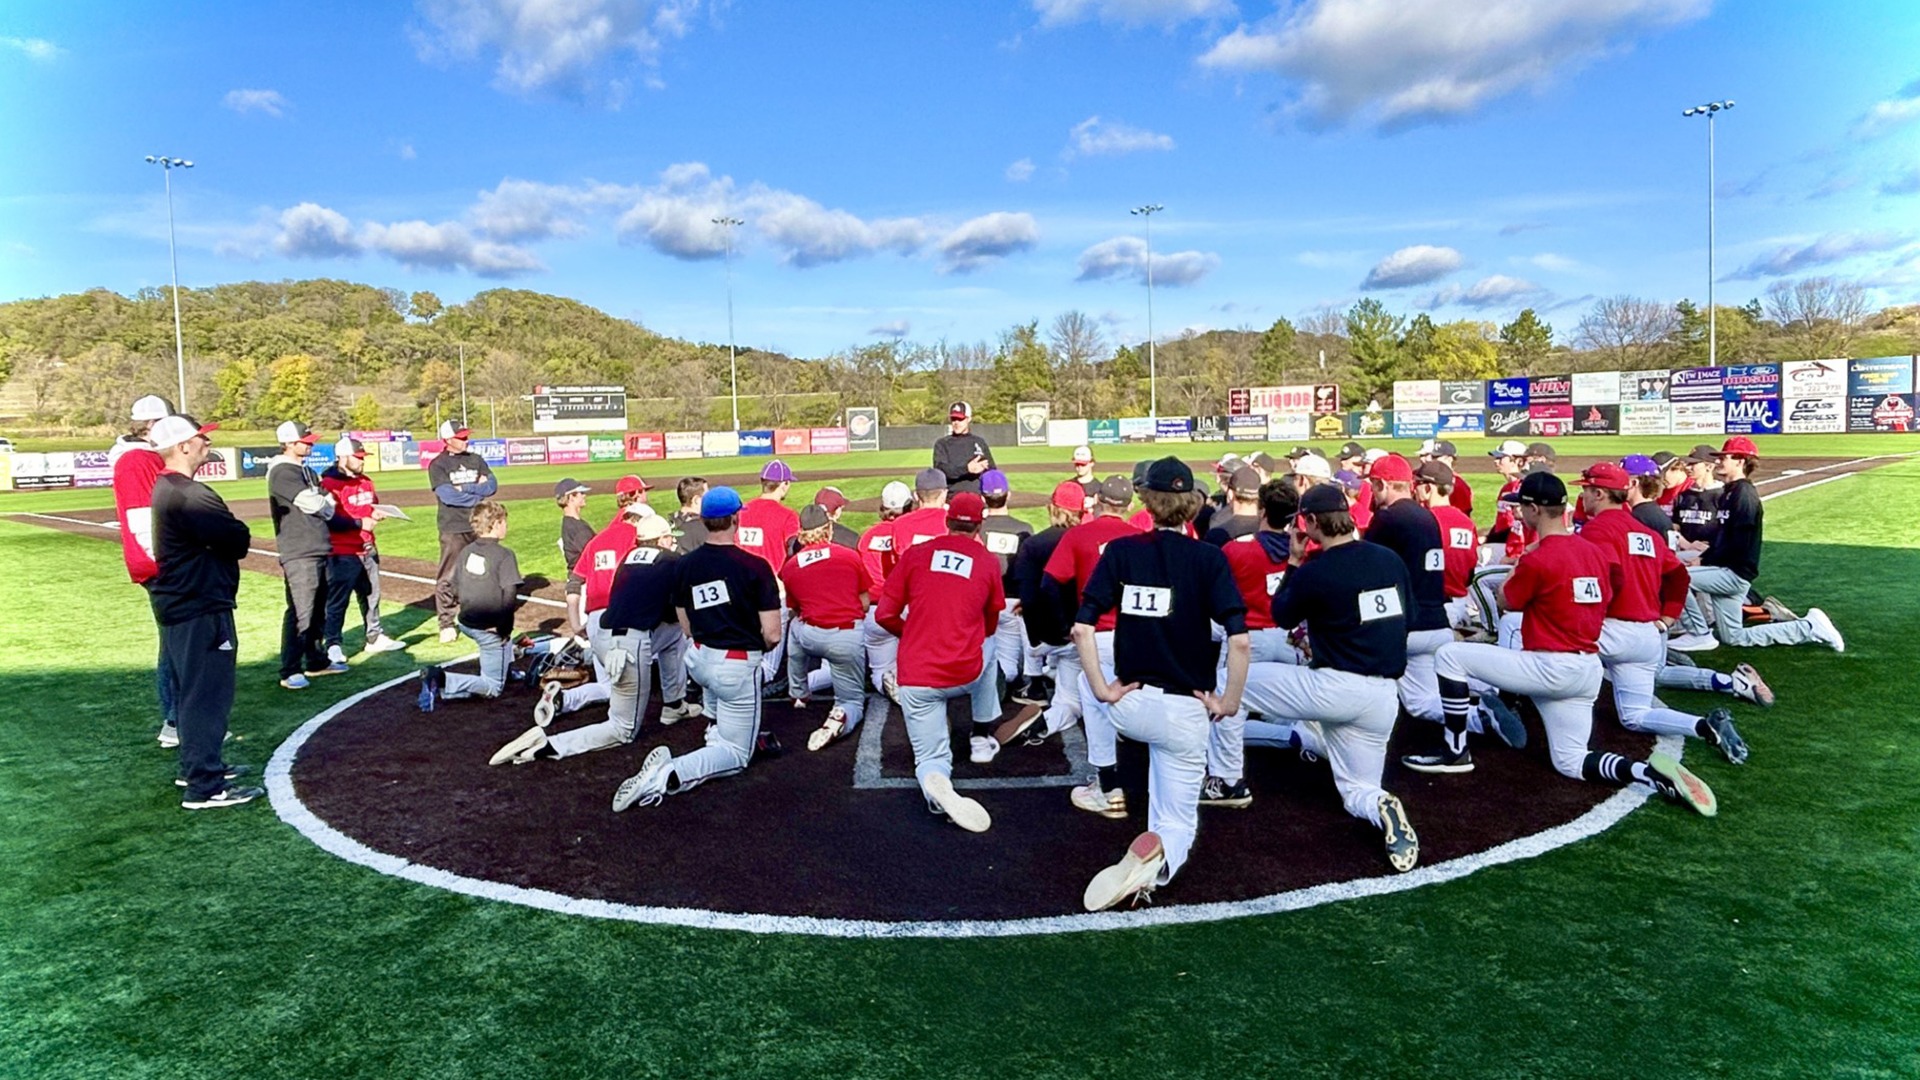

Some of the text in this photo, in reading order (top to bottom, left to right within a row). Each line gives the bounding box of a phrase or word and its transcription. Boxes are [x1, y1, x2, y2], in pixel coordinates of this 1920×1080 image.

[1261, 392, 1311, 410] LIQUOR
[1795, 399, 1836, 409] GLASS
[743, 530, 757, 543] 27
[998, 537, 1008, 549] 9
[1456, 532, 1469, 545] 21
[1636, 537, 1651, 552] 30
[633, 551, 648, 561] 61
[805, 550, 823, 562] 28
[941, 555, 965, 571] 17
[1433, 552, 1440, 567] 3
[699, 586, 720, 604] 13
[1584, 582, 1599, 598] 41
[1131, 592, 1158, 611] 11
[1374, 594, 1387, 613] 8
